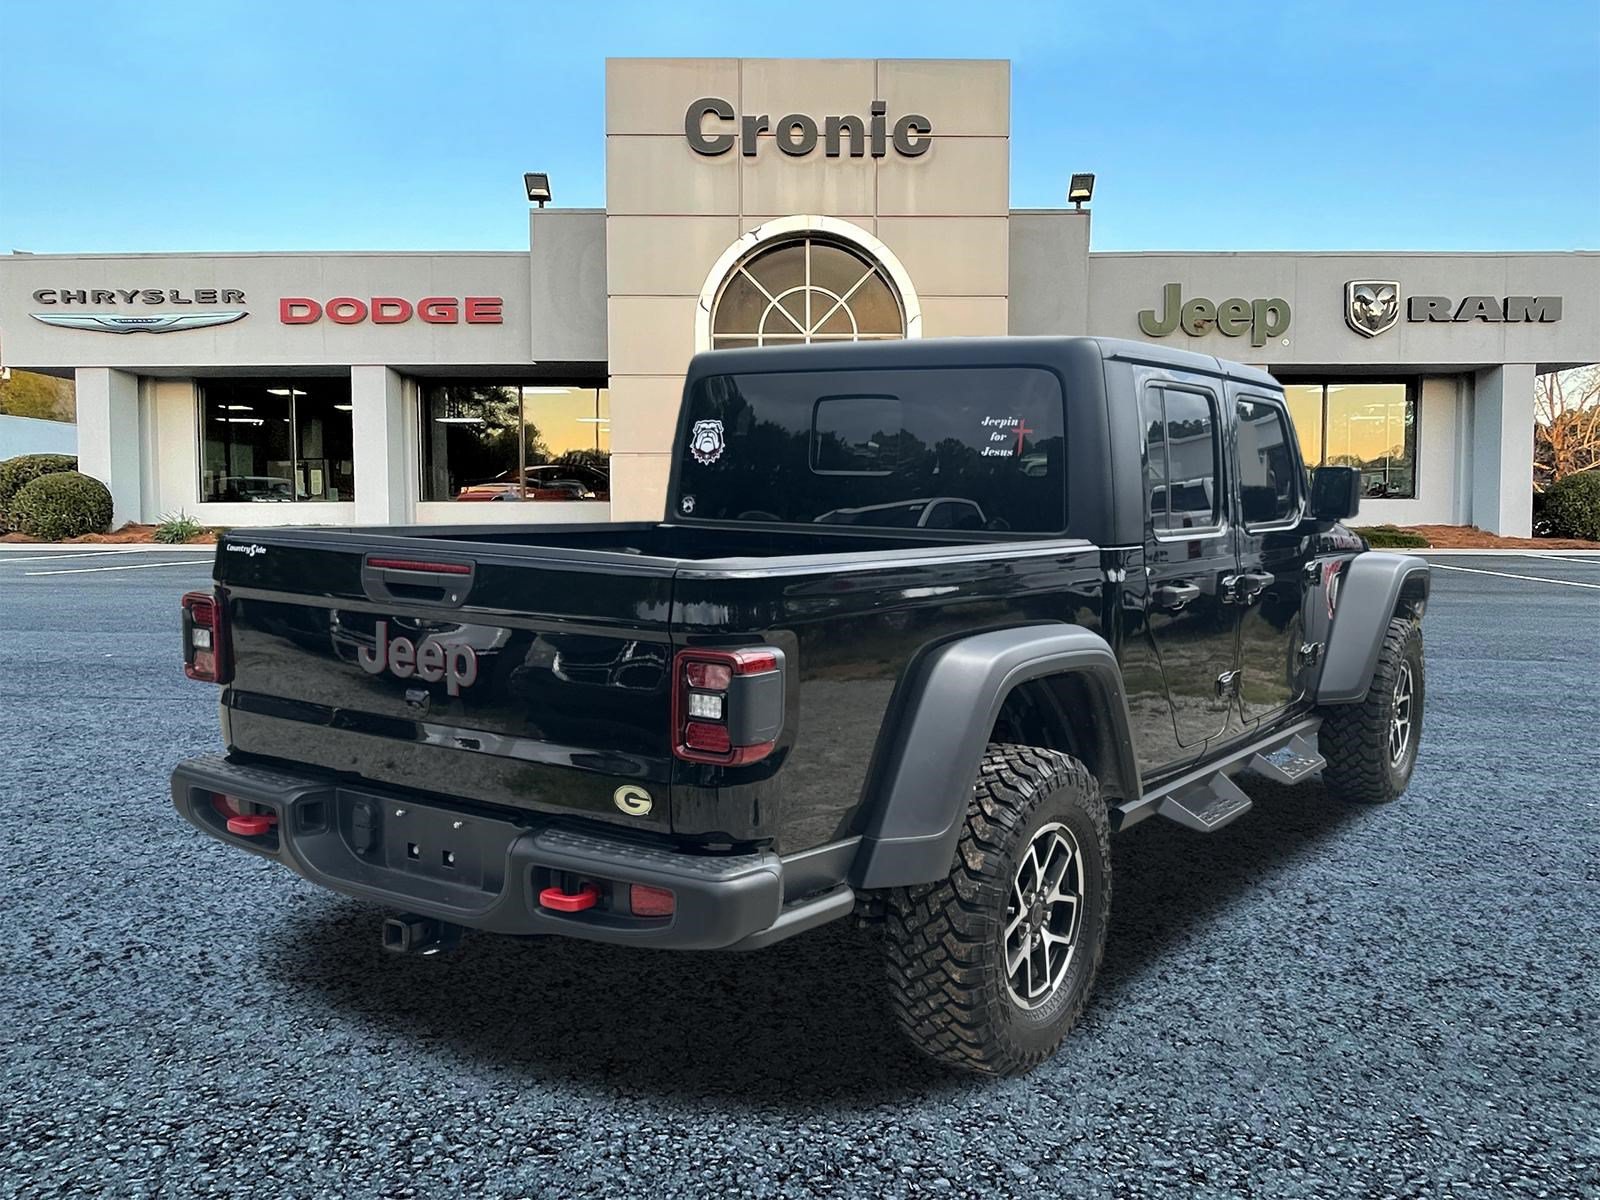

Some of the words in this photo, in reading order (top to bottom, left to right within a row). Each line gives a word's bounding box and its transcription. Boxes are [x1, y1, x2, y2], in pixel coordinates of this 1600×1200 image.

[685, 97, 932, 157] Cronic
[32, 288, 247, 305] CHRYSLER
[1407, 296, 1563, 323] RAM
[279, 296, 504, 325] DODGE
[1138, 283, 1292, 347] Jeep
[981, 416, 1019, 429] Jeepin
[990, 431, 1007, 441] for
[981, 446, 1014, 457] Jesus
[357, 620, 478, 697] Jeep
